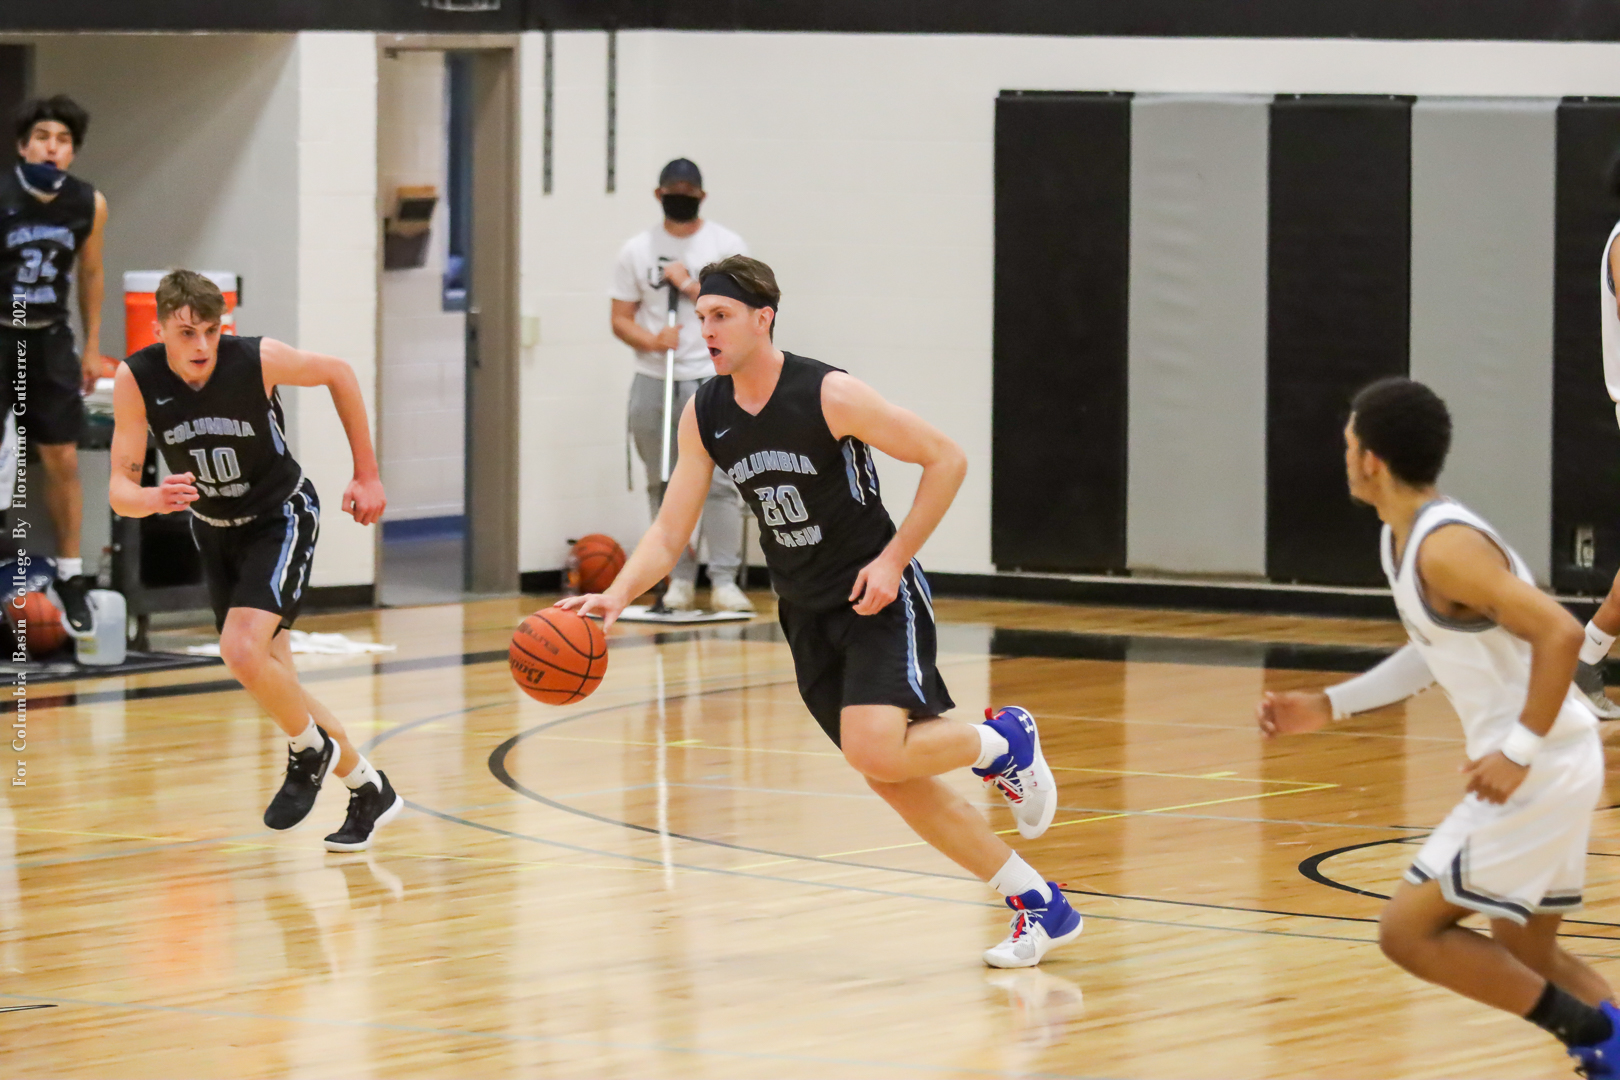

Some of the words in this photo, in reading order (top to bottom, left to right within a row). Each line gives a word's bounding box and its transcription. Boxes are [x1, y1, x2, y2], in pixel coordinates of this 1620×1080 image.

[163, 417, 256, 445] COLUMBIA
[189, 447, 242, 484] 10
[727, 450, 818, 485] COLUMBIA
[753, 485, 809, 527] 20
